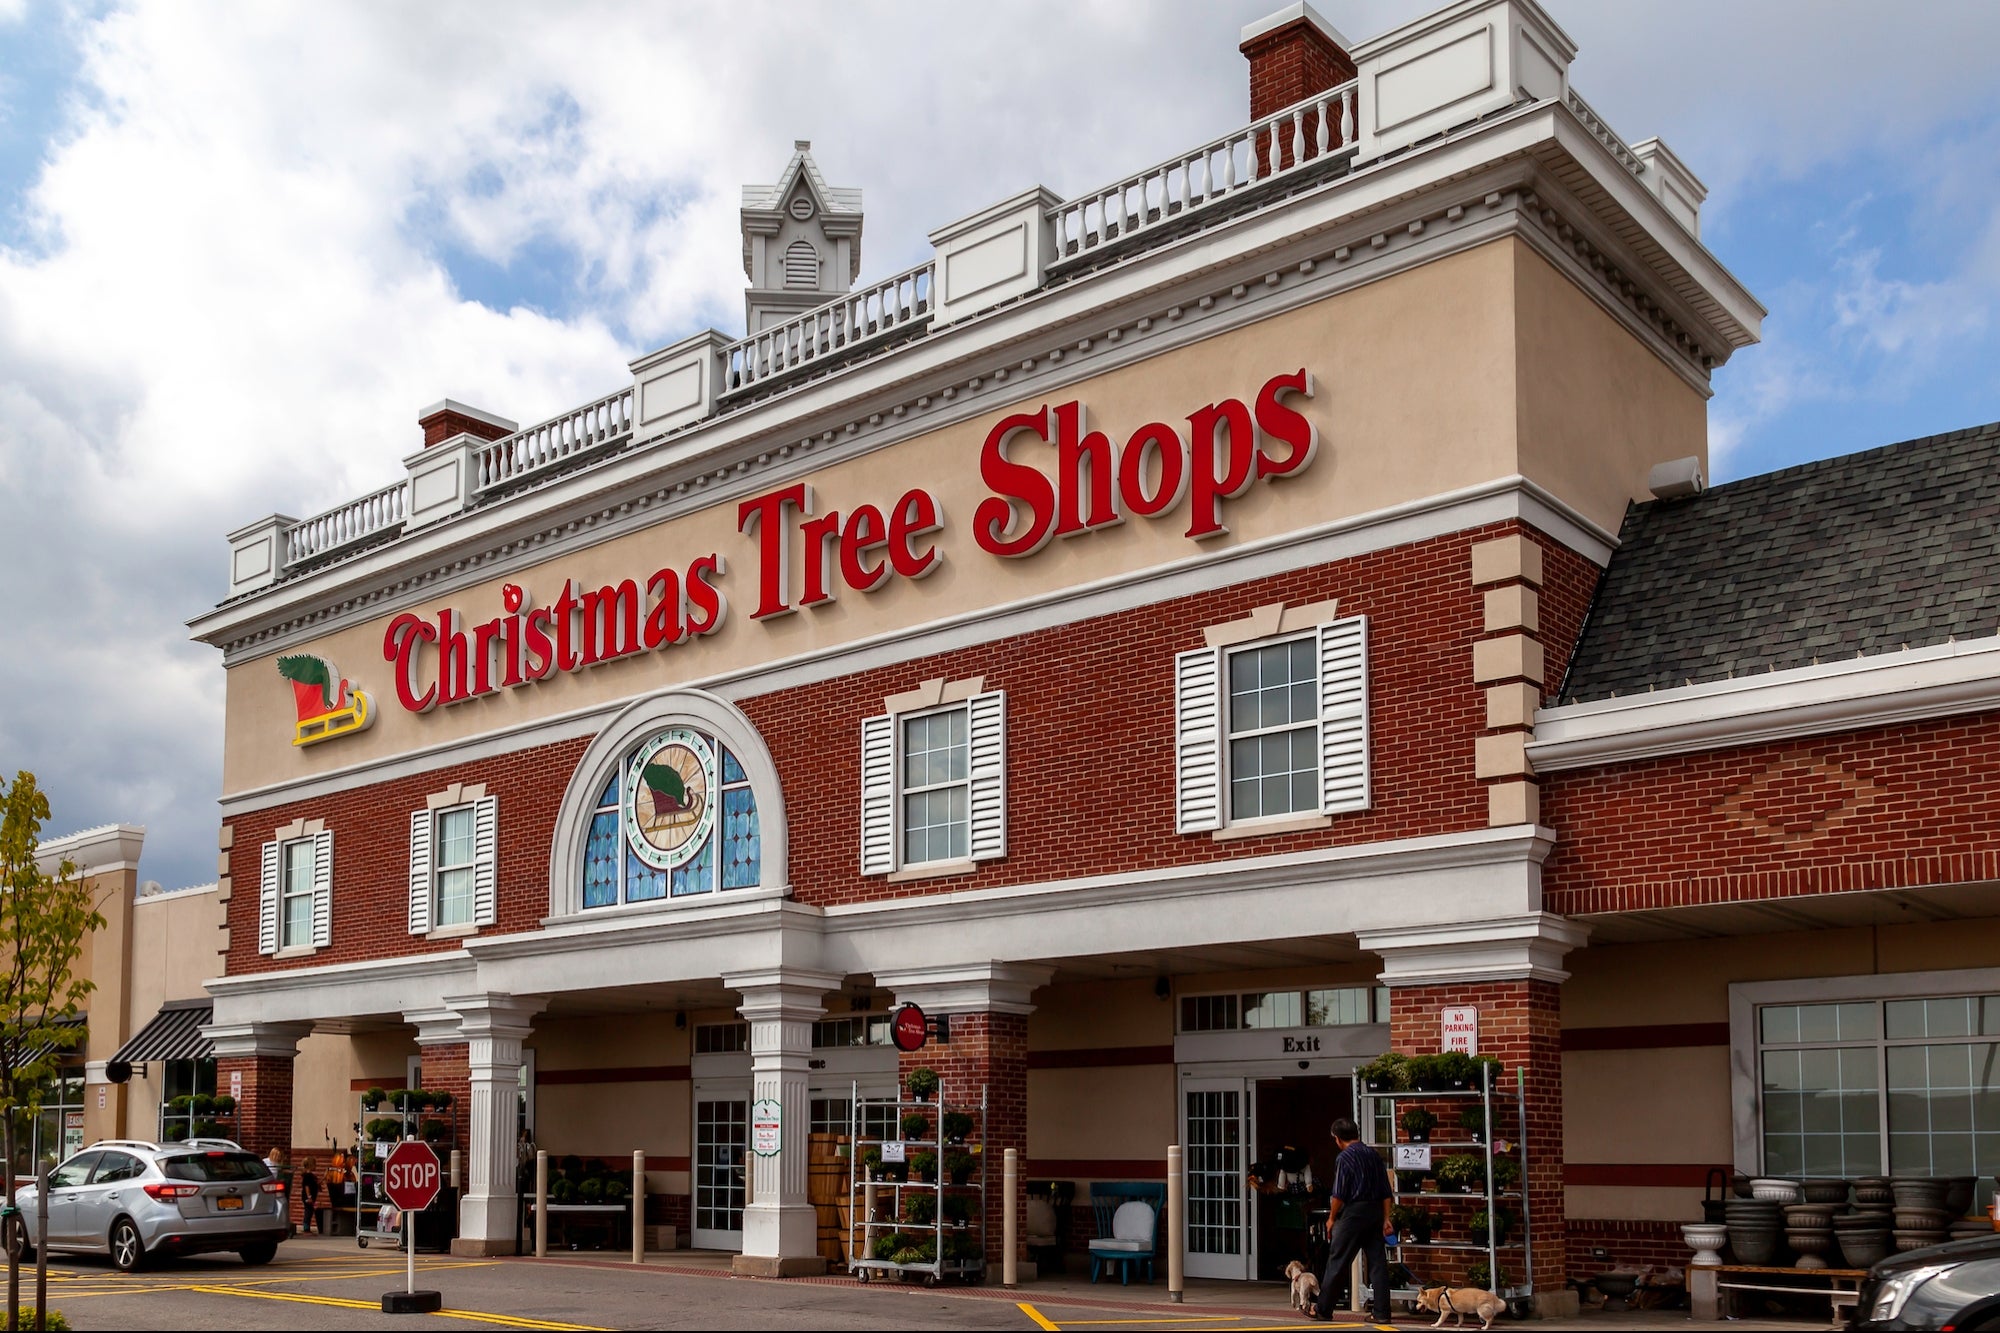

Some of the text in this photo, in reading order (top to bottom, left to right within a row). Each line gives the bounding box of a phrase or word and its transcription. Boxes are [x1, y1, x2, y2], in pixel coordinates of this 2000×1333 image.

[383, 367, 1318, 714] Christmas Tree Shops
[1454, 1013, 1464, 1021] NO
[1445, 1023, 1474, 1032] PARKING
[1282, 1035, 1321, 1053] Exit
[1451, 1036, 1468, 1046] FIRE
[1403, 1148, 1410, 1159] 2
[389, 1163, 437, 1190] STOP
